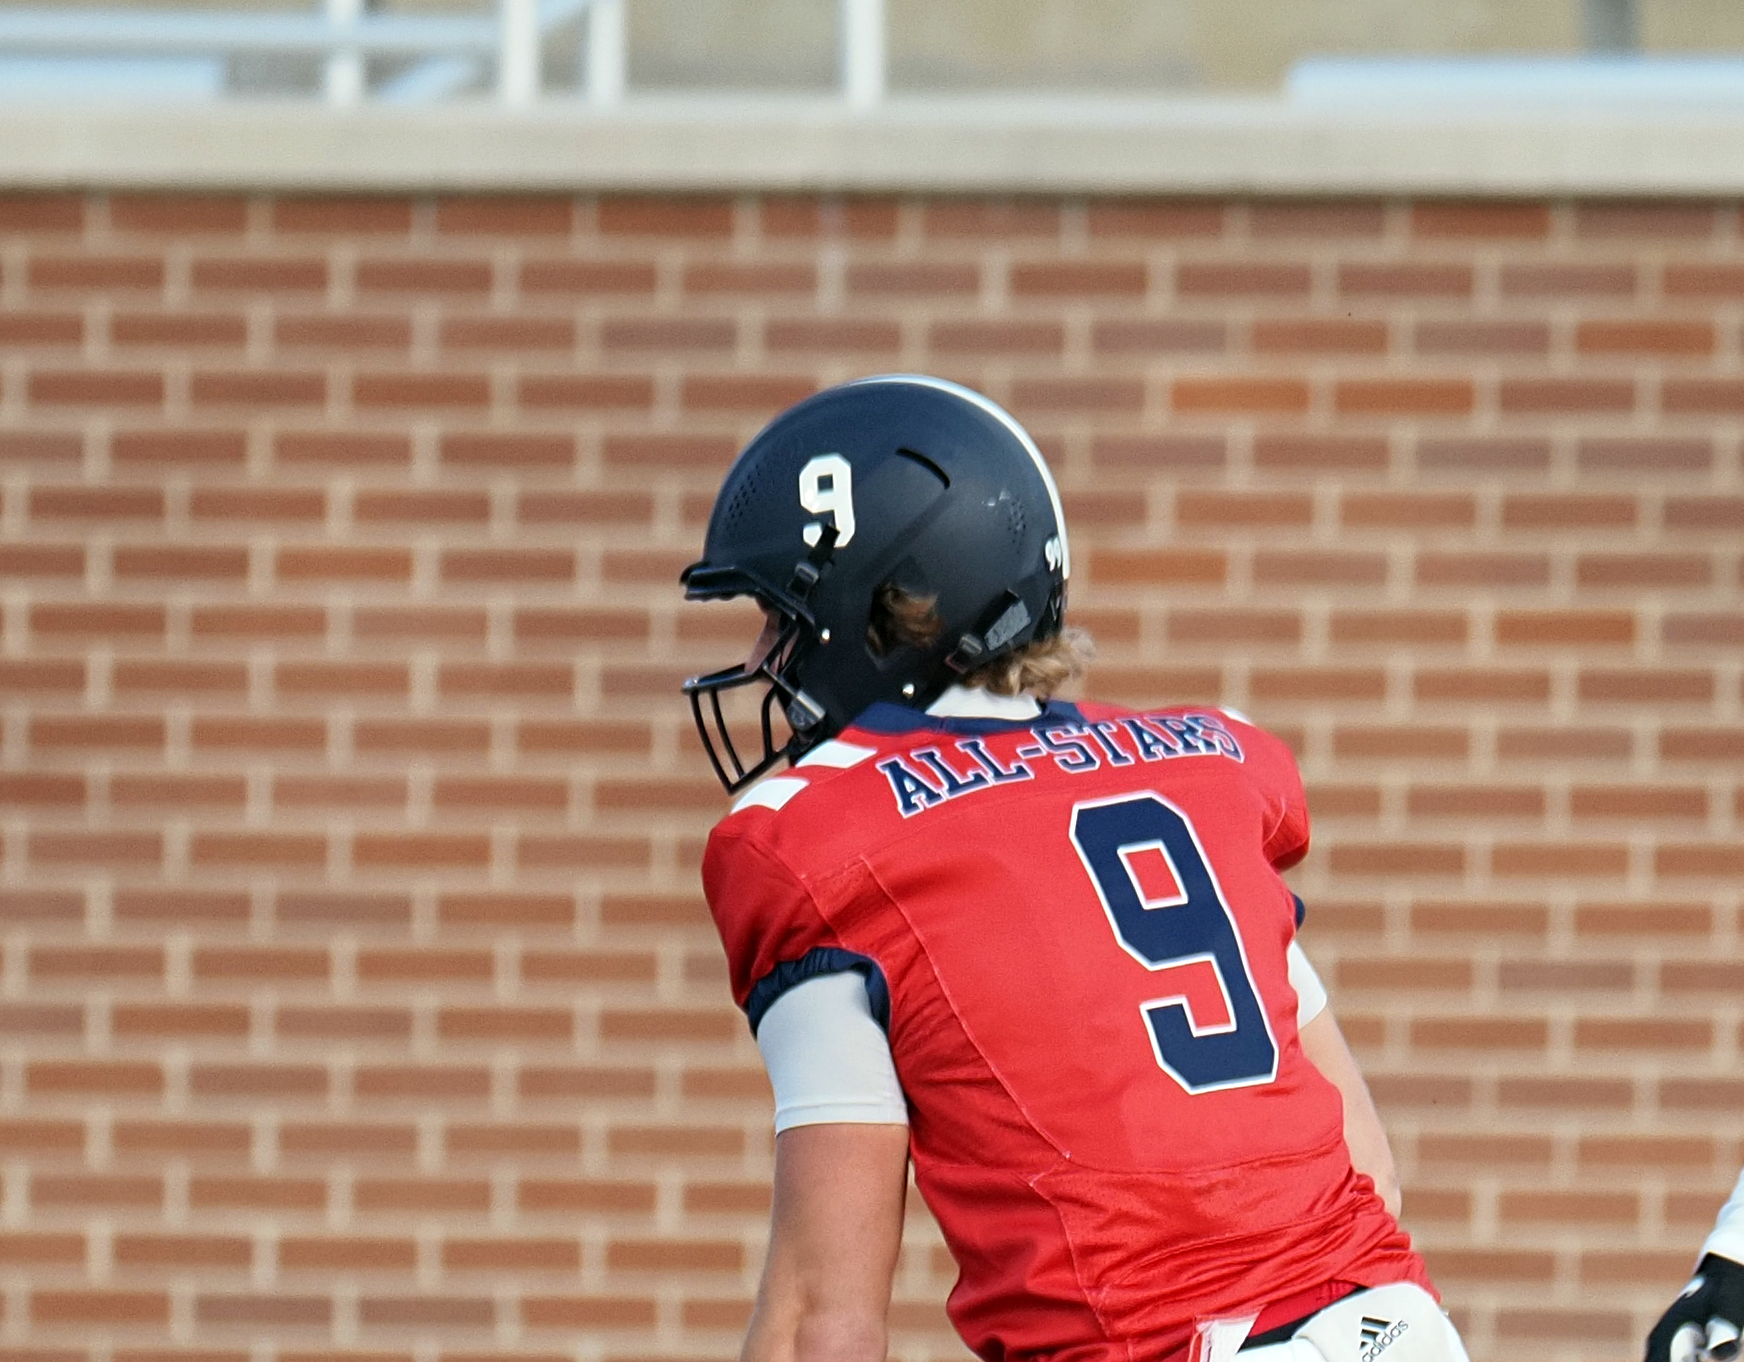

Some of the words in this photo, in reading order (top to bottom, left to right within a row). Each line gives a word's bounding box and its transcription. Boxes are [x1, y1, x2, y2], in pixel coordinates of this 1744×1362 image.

[799, 453, 855, 549] 9
[875, 714, 1245, 819] ALL-STARS
[1069, 790, 1280, 1095] 9
